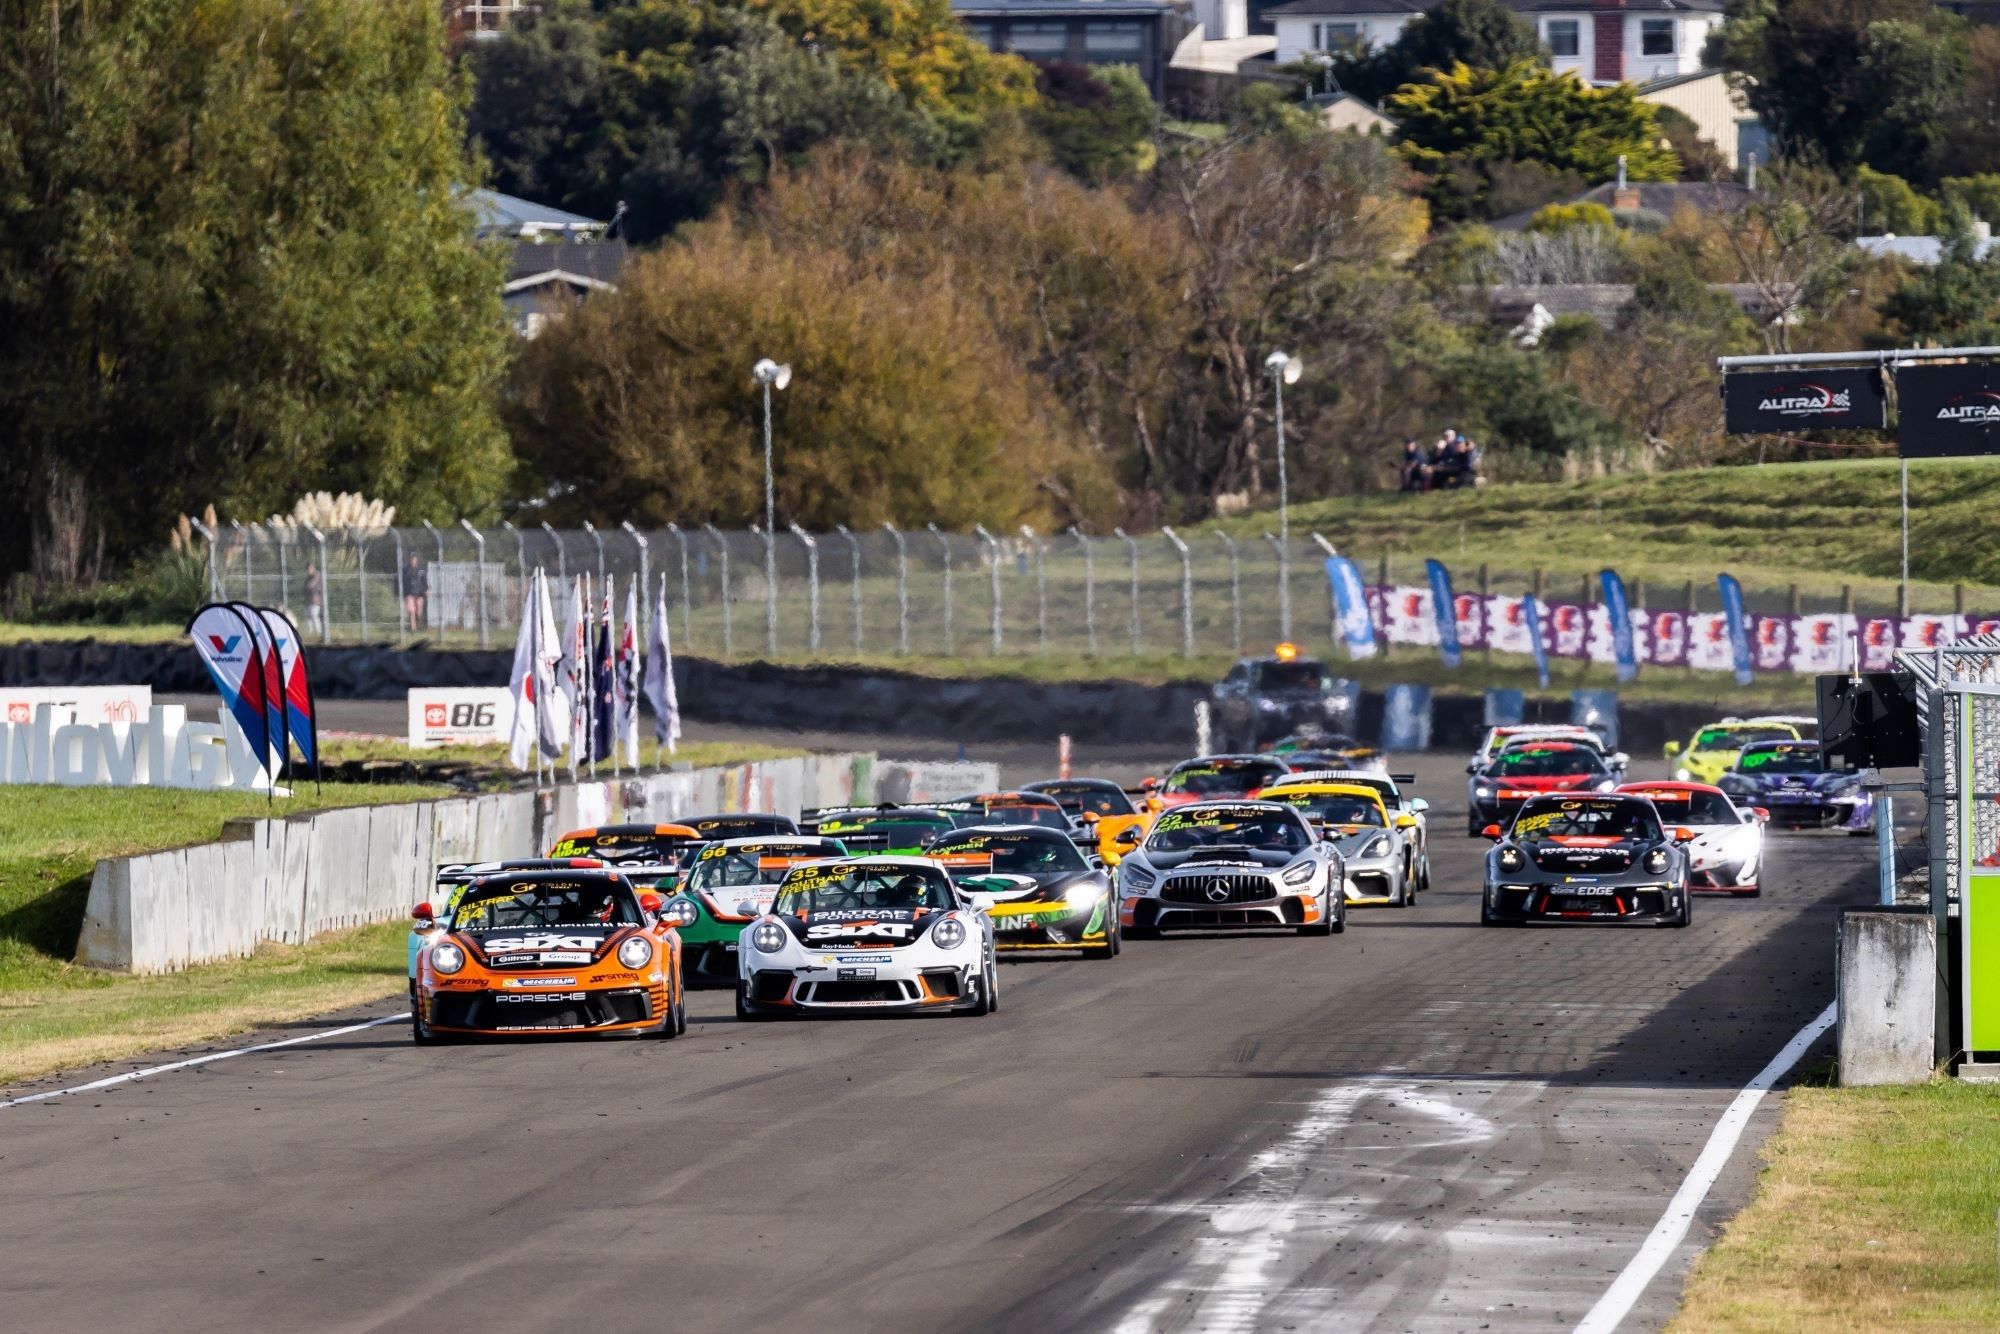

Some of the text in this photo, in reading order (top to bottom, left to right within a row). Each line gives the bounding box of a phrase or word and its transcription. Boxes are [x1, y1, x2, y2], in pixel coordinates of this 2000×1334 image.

[1936, 405, 2000, 419] AUTRA
[450, 702, 496, 727] 86
[1157, 814, 1183, 828] 22
[702, 847, 727, 860] 96
[791, 866, 819, 881] 35
[1577, 886, 1615, 896] EDGE
[458, 895, 515, 914] GILTRAP
[807, 921, 913, 938] SIXT
[484, 934, 604, 952] SIXT
[498, 954, 535, 963] Giltrap
[457, 978, 490, 987] smeg
[522, 977, 576, 986] MICHELIN
[606, 972, 640, 982] smeg
[496, 992, 586, 1003] PORSCHE
